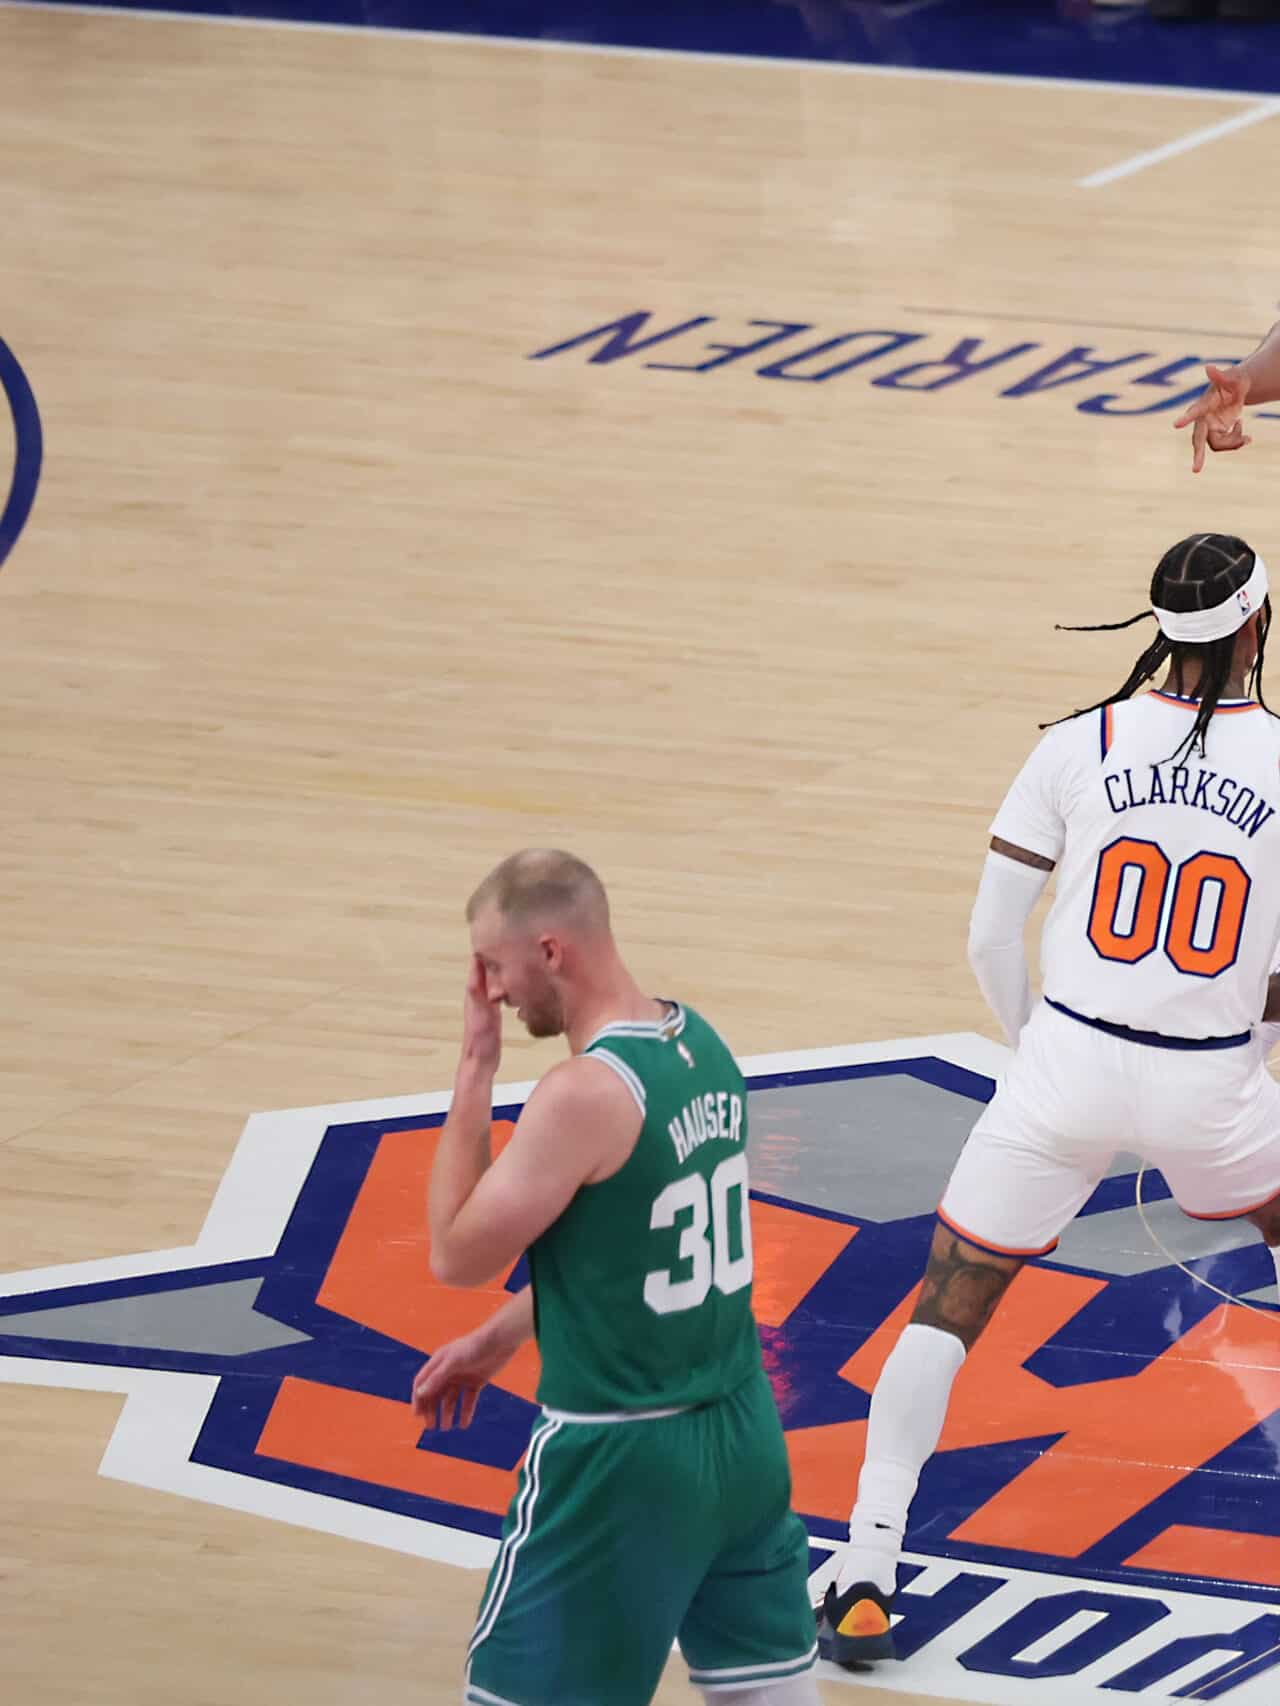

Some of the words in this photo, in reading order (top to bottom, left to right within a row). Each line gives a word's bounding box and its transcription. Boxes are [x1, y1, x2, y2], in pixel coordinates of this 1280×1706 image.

[1104, 765, 1275, 839] CLARKSON
[1086, 835, 1252, 978] 00
[667, 1091, 743, 1166] HAUSER
[643, 1151, 754, 1315] 30
